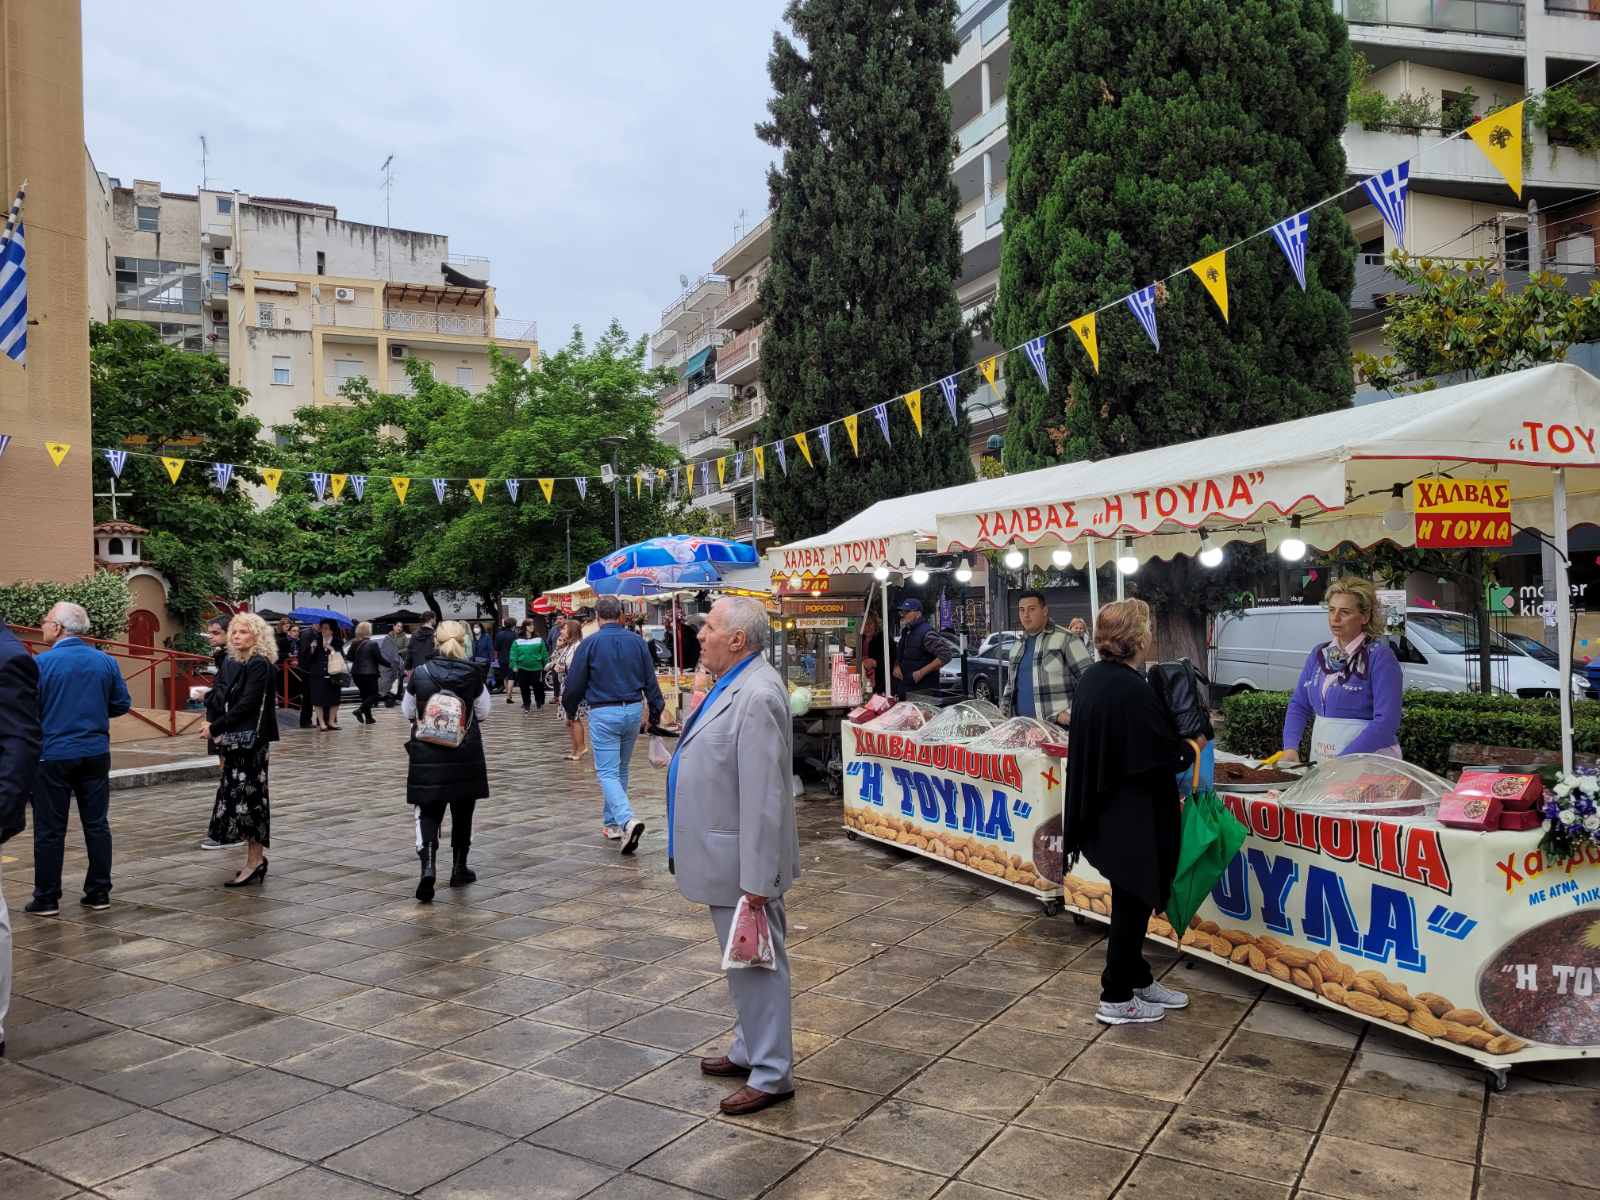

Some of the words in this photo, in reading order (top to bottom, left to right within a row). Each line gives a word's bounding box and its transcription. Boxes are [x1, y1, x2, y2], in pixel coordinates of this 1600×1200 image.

[1418, 483, 1510, 508] ΧΑΛΒΑΣ
[976, 501, 1079, 538] ΧΑΛΒΑΣ
[1418, 520, 1433, 540] Η
[1440, 520, 1509, 540] ΤΟΥΛΑ
[783, 548, 826, 569] ΧΑΛΒΑΣ
[1528, 889, 1546, 906] ΜΕ
[1549, 879, 1579, 898] ΑΓΝΑ
